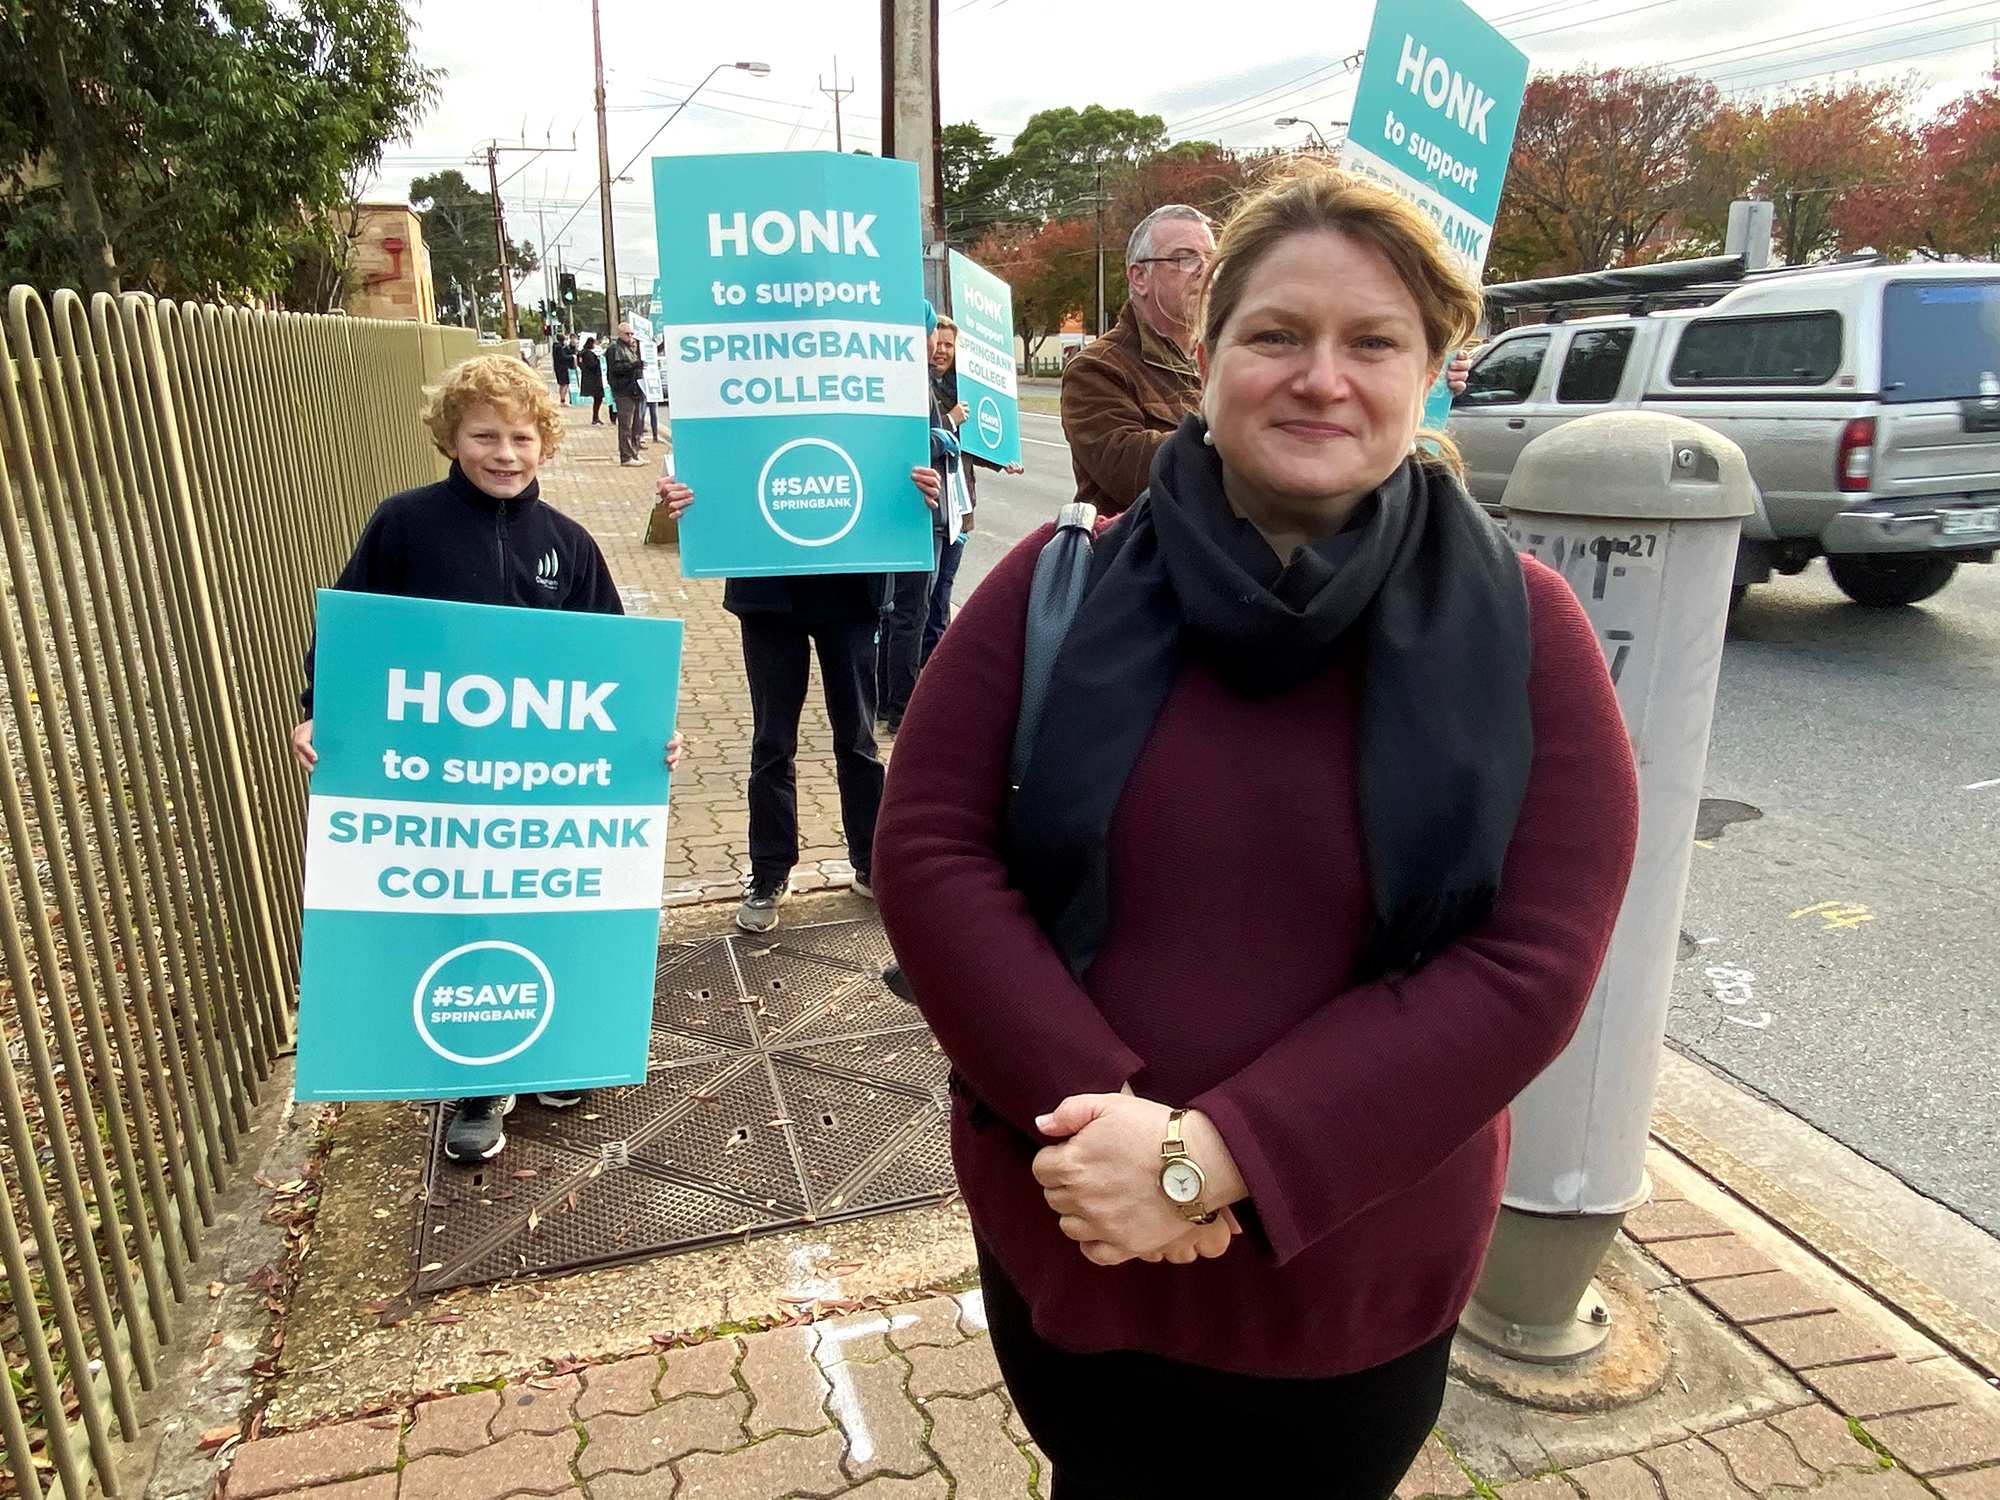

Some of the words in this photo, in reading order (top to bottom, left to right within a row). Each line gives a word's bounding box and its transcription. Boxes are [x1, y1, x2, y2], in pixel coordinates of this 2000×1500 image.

[1396, 33, 1496, 144] HONK
[1384, 110, 1405, 145] to
[1408, 132, 1478, 194] support
[708, 210, 880, 258] HONK
[712, 281, 746, 306] to
[756, 280, 881, 308] support
[963, 284, 1003, 324] HONK
[965, 314, 975, 329] to
[975, 322, 1004, 345] support
[679, 331, 915, 363] SPRINGBANK
[958, 338, 1013, 374] SPRINGBANK
[720, 375, 885, 405] COLLEGE
[968, 360, 1007, 389] COLLEGE
[771, 475, 851, 497] #SAVE
[772, 498, 852, 511] SPRINGBANK
[386, 668, 620, 732] HONK
[383, 749, 430, 781] to
[442, 756, 612, 791] support
[328, 811, 651, 850] SPRINGBANK
[377, 866, 603, 900] COLLEGE
[432, 983, 539, 1007] #SAVE
[431, 1008, 537, 1024] SPRINGBANK
